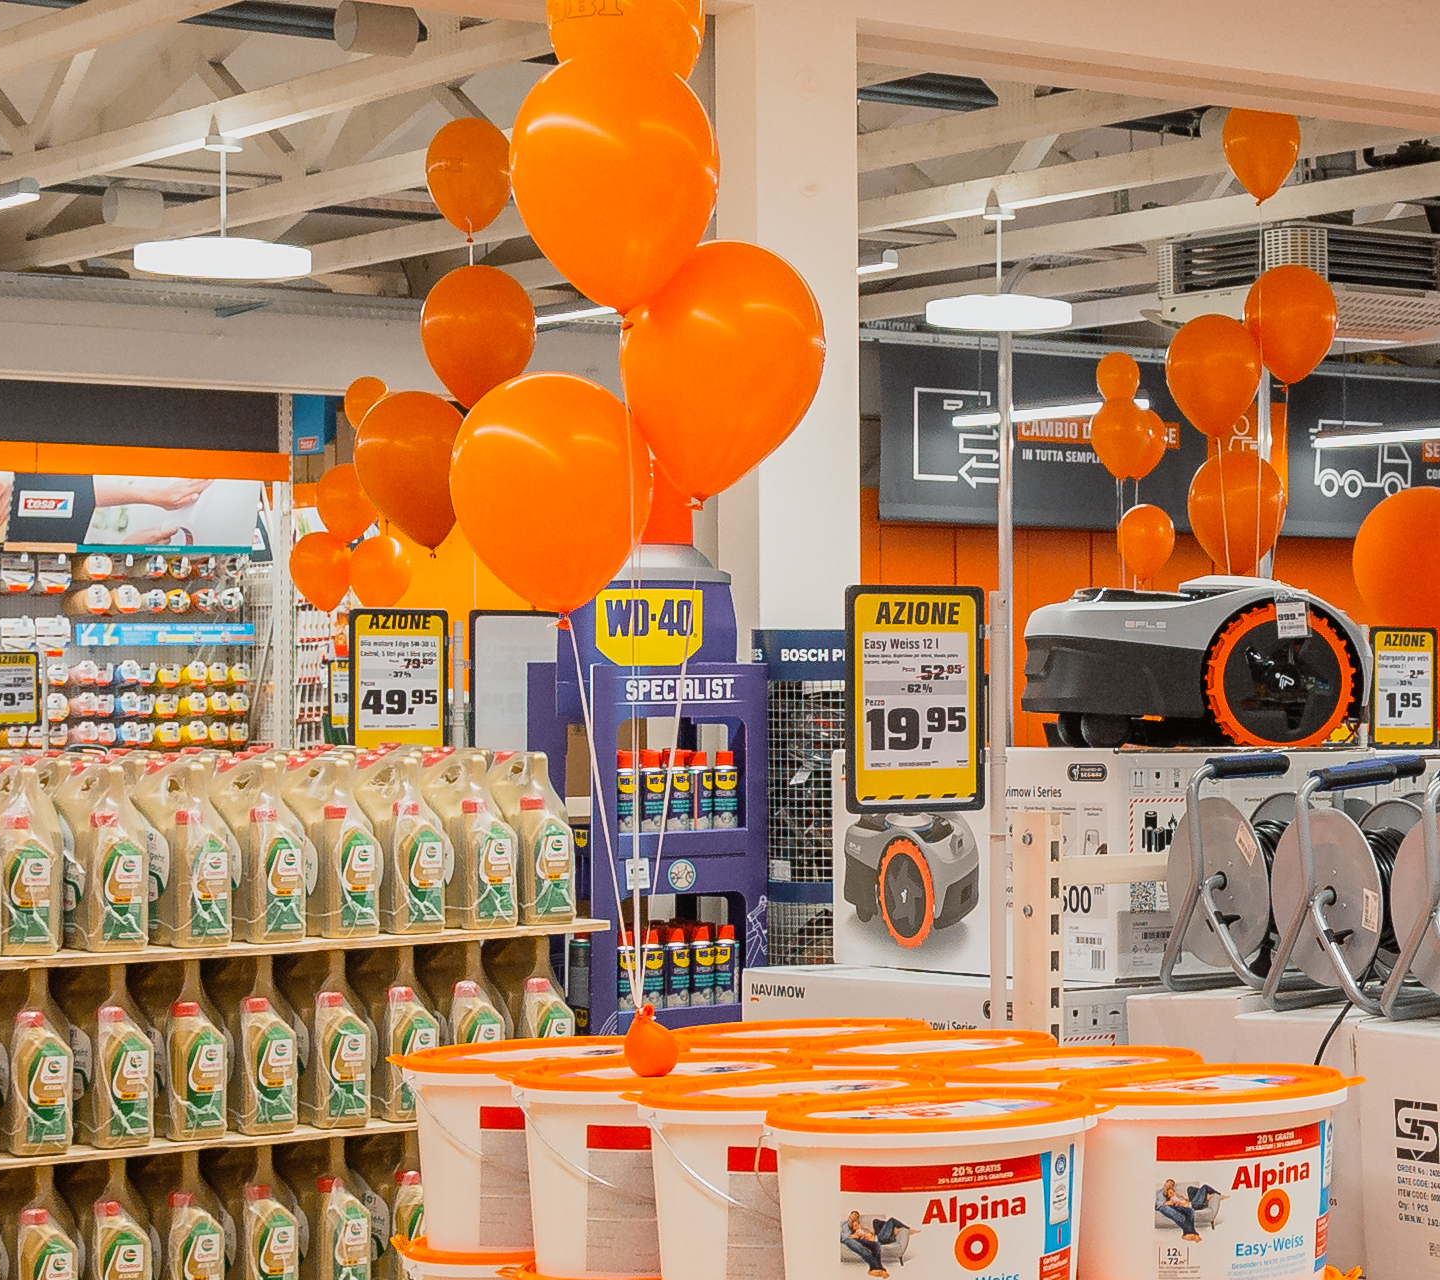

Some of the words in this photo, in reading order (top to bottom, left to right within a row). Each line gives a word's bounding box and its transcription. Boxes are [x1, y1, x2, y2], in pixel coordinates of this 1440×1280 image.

[1021, 420, 1078, 439] CAMBIO
[369, 614, 431, 630] AZIONE
[876, 602, 960, 625] AZIONE
[864, 638, 887, 651] Easy
[890, 638, 920, 650] Weiss
[923, 638, 934, 649] 12
[1384, 634, 1426, 647] AZIONE
[780, 649, 828, 662] BOSCH
[625, 679, 734, 701] SPECIALIST
[361, 689, 437, 715] 49,95
[865, 699, 885, 707] Pezzo
[1386, 692, 1422, 718] 1,95
[866, 707, 967, 751] 19,95
[1042, 786, 1062, 798] Series
[751, 983, 806, 1000] NAVIMOW
[951, 1165, 972, 1178] 20%
[974, 1163, 1002, 1176] GRATIS
[1231, 1161, 1310, 1196] Alpina
[922, 1192, 1027, 1230] Alpina
[1234, 1234, 1305, 1258] Easy-Weiss
